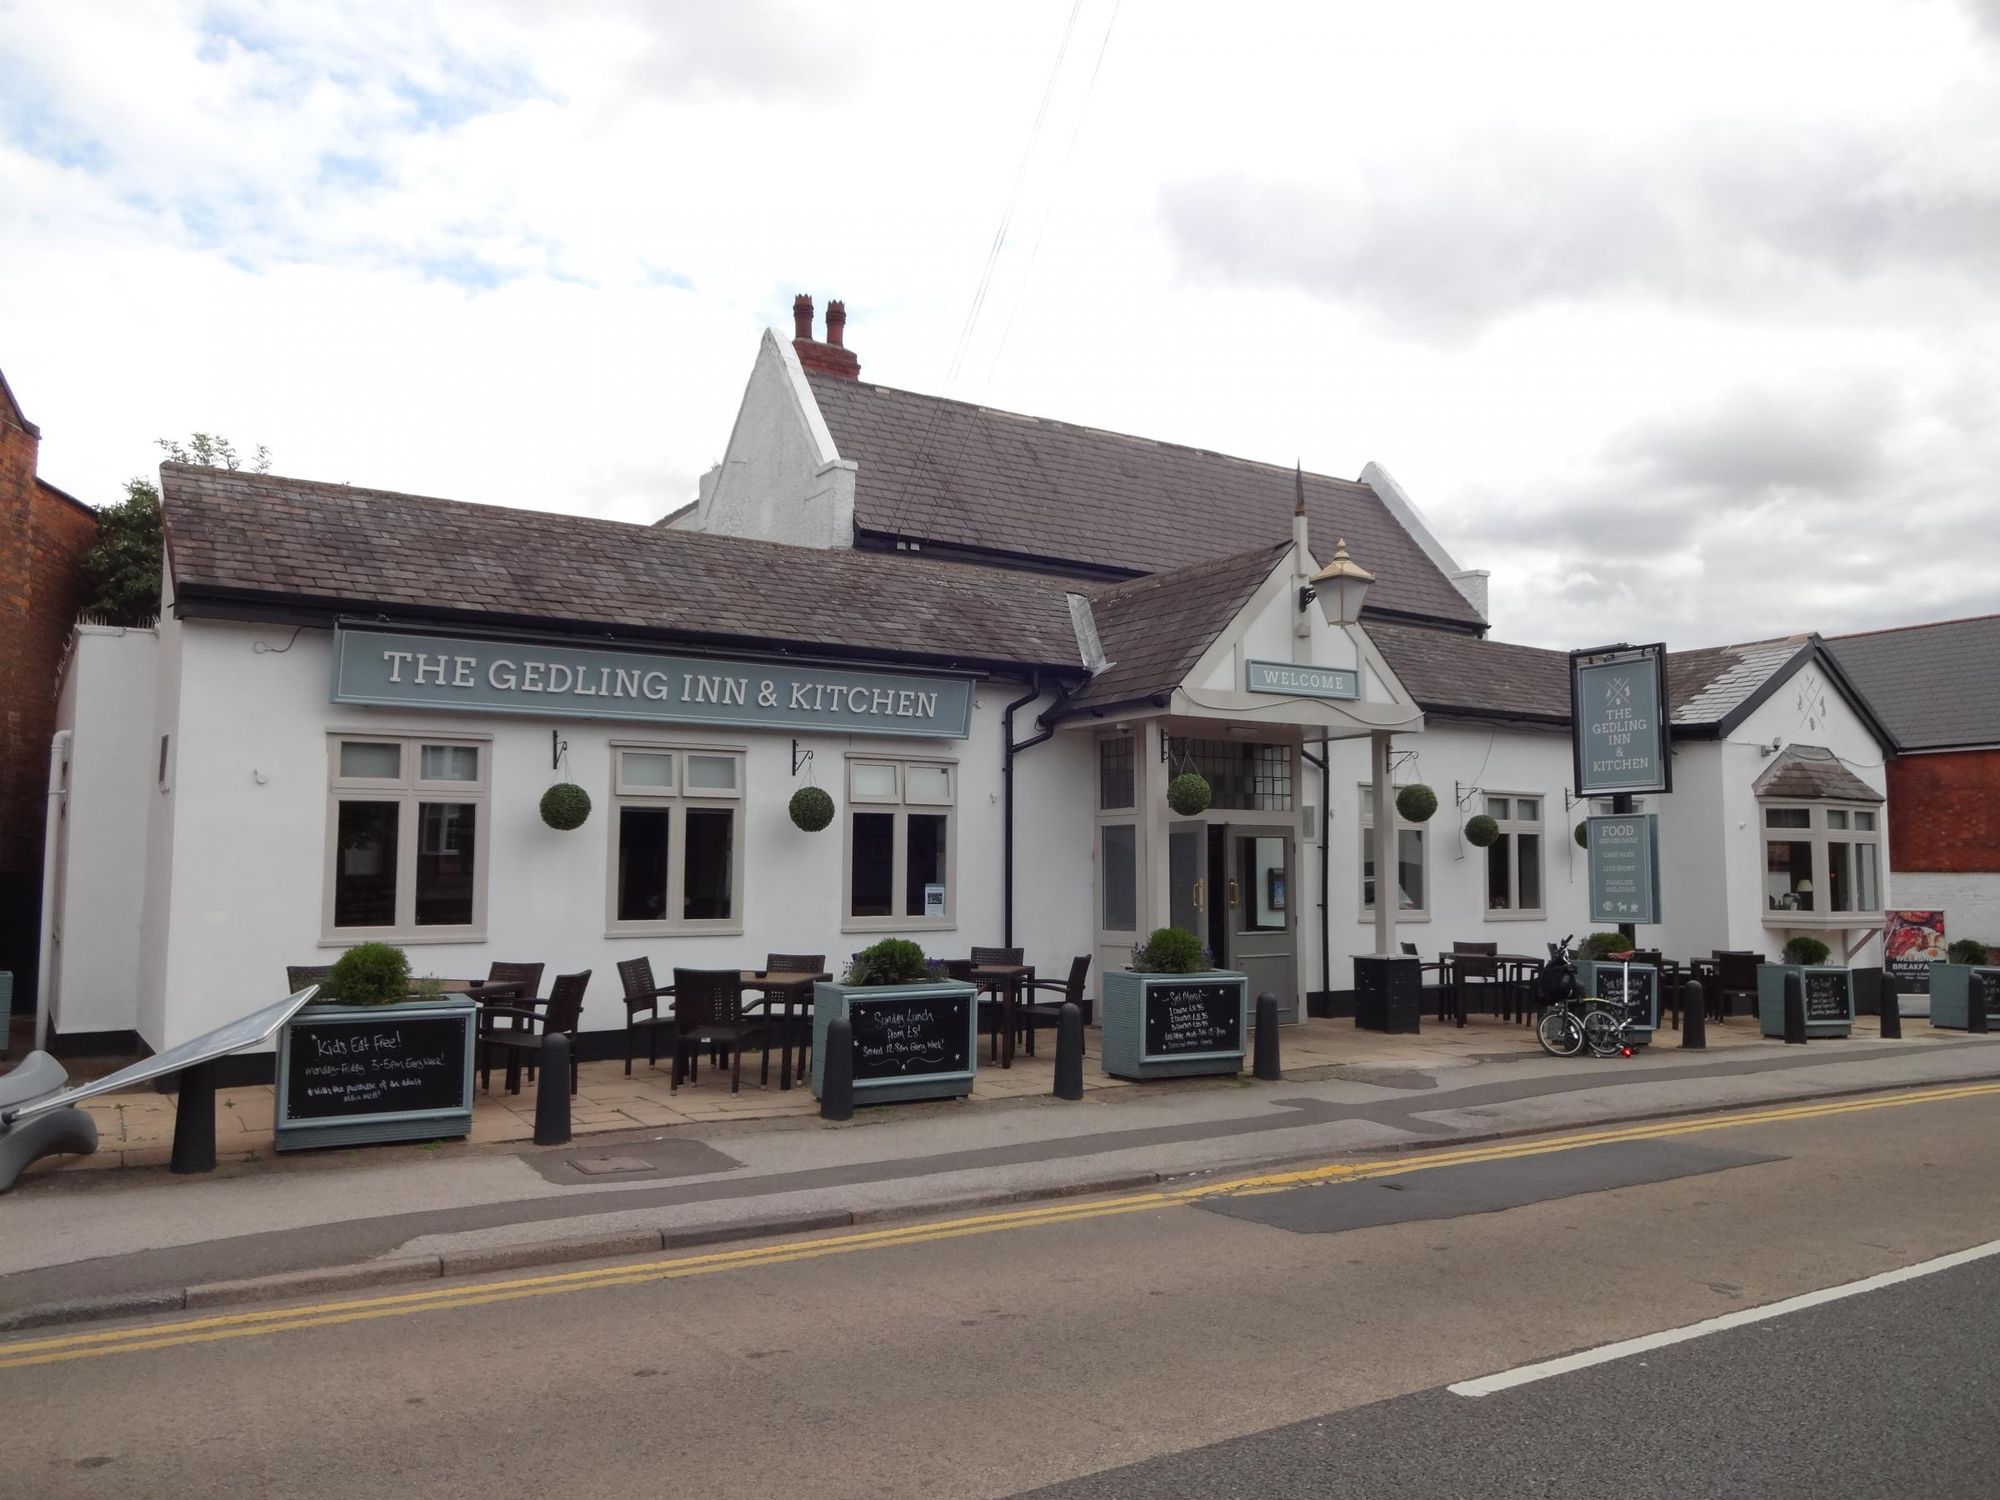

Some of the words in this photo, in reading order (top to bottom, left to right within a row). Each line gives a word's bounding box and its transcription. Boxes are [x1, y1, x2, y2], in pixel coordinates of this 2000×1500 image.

[384, 650, 477, 688] THE
[488, 659, 668, 700] GEDLING
[681, 674, 748, 705] INN
[758, 680, 778, 707] &
[788, 682, 938, 718] KITCHEN
[1263, 670, 1344, 690] WELCOME
[1606, 708, 1632, 720] THE
[1592, 719, 1647, 734] GEDLING
[1608, 733, 1631, 746] INN
[1616, 747, 1624, 757] &
[1592, 757, 1649, 772] KITCHEN
[1602, 825, 1634, 836] FOOD
[1170, 991, 1181, 1005] Set
[874, 1011, 905, 1028] Sunday
[907, 1008, 934, 1022] Lunch
[317, 1039, 347, 1056] Kids
[351, 1036, 369, 1052] Eat
[374, 1030, 401, 1051] Free!
